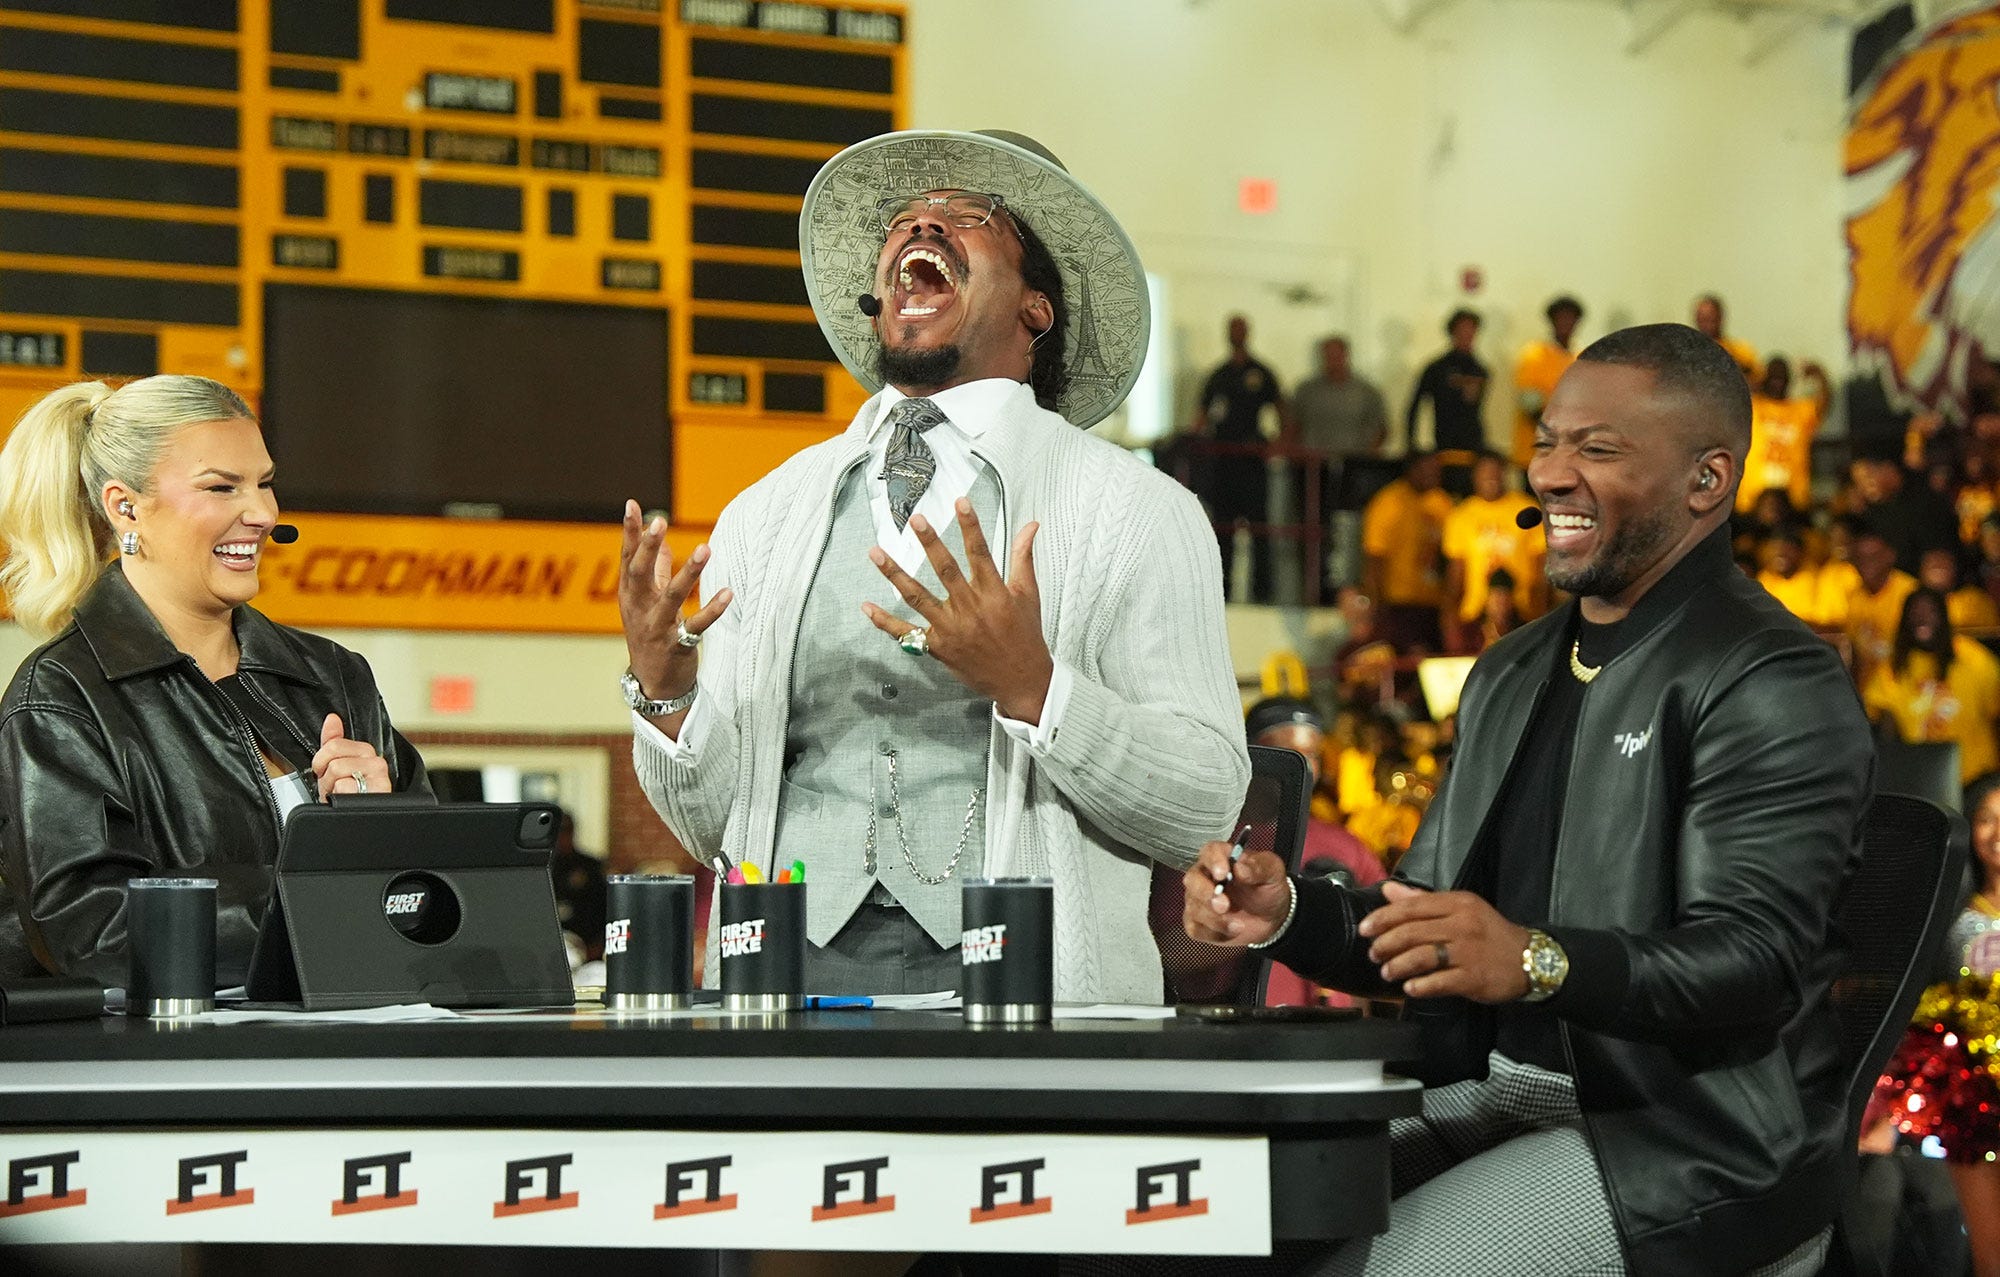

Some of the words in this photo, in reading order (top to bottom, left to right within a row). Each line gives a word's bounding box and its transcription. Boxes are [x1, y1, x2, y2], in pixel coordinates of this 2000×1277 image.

[385, 902, 420, 914] TAKE
[386, 893, 425, 905] FIRST
[605, 919, 630, 939] RST
[721, 919, 765, 942] FIRST
[962, 924, 1006, 947] FIRST
[604, 937, 627, 955] AKE
[721, 937, 762, 958] TAKE
[8, 1150, 80, 1205] FT
[178, 1150, 248, 1203] FT
[343, 1151, 411, 1205] FT
[505, 1153, 573, 1206] FT
[665, 1155, 732, 1208] FT
[822, 1156, 889, 1210] FT
[980, 1158, 1045, 1211] FT
[1136, 1159, 1200, 1213] FT
